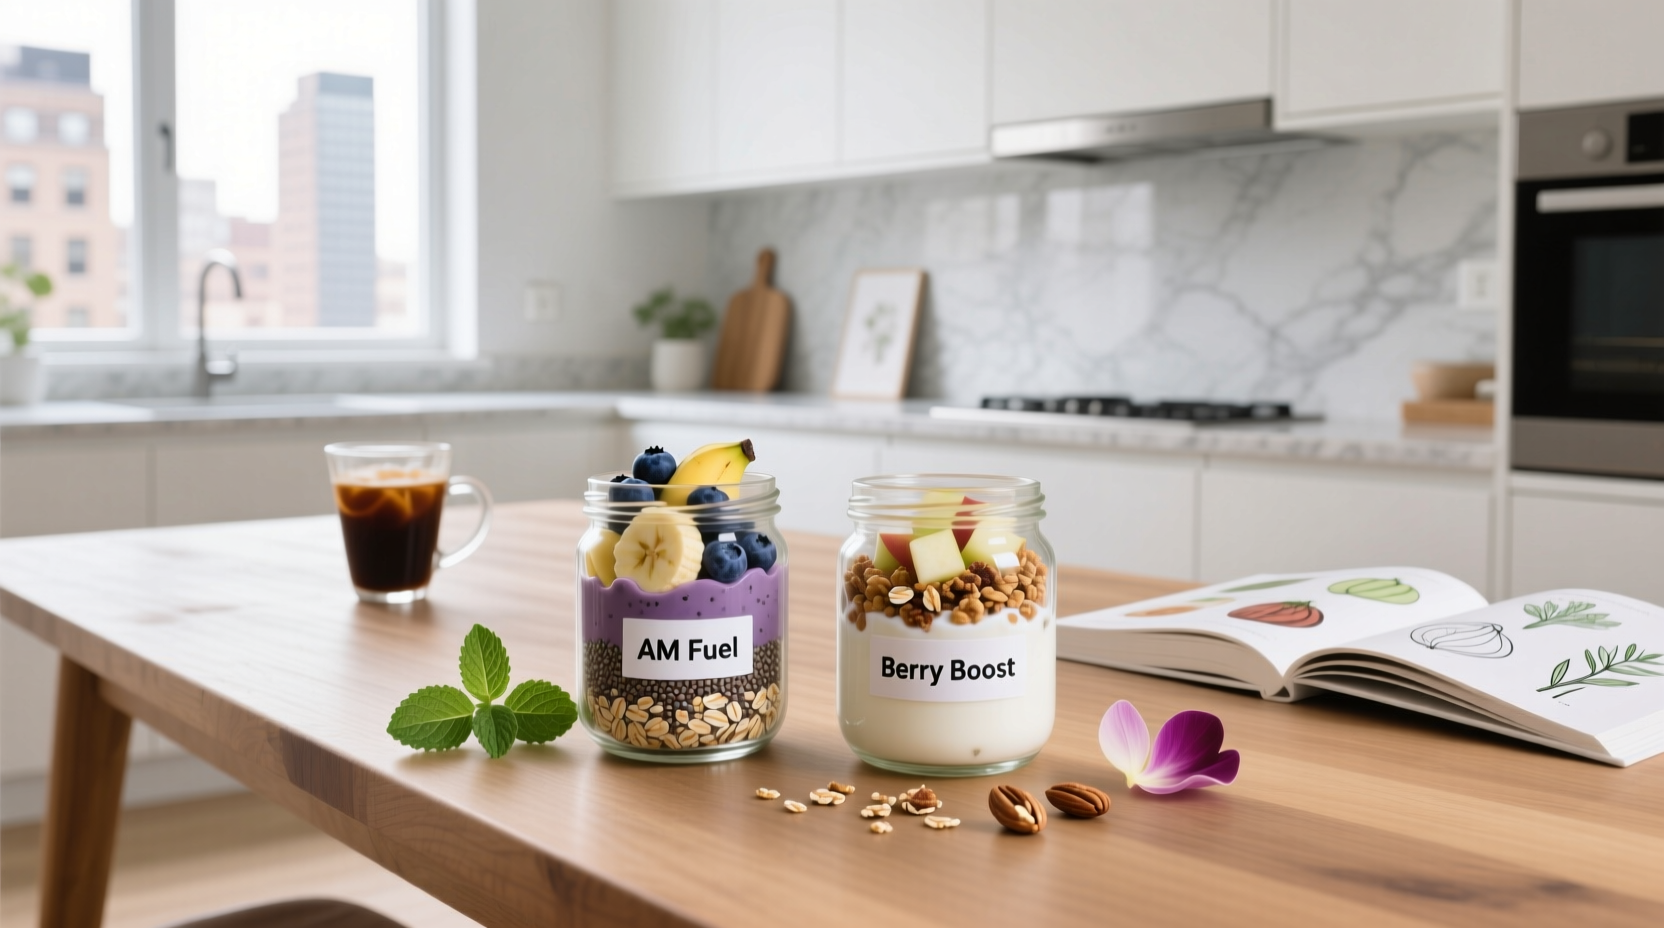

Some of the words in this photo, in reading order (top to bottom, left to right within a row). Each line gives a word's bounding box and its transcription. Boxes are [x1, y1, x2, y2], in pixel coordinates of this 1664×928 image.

[636, 637, 681, 662] AM
[687, 636, 738, 661] Fuel
[880, 655, 944, 687] Berry
[949, 657, 1016, 681] Boost
